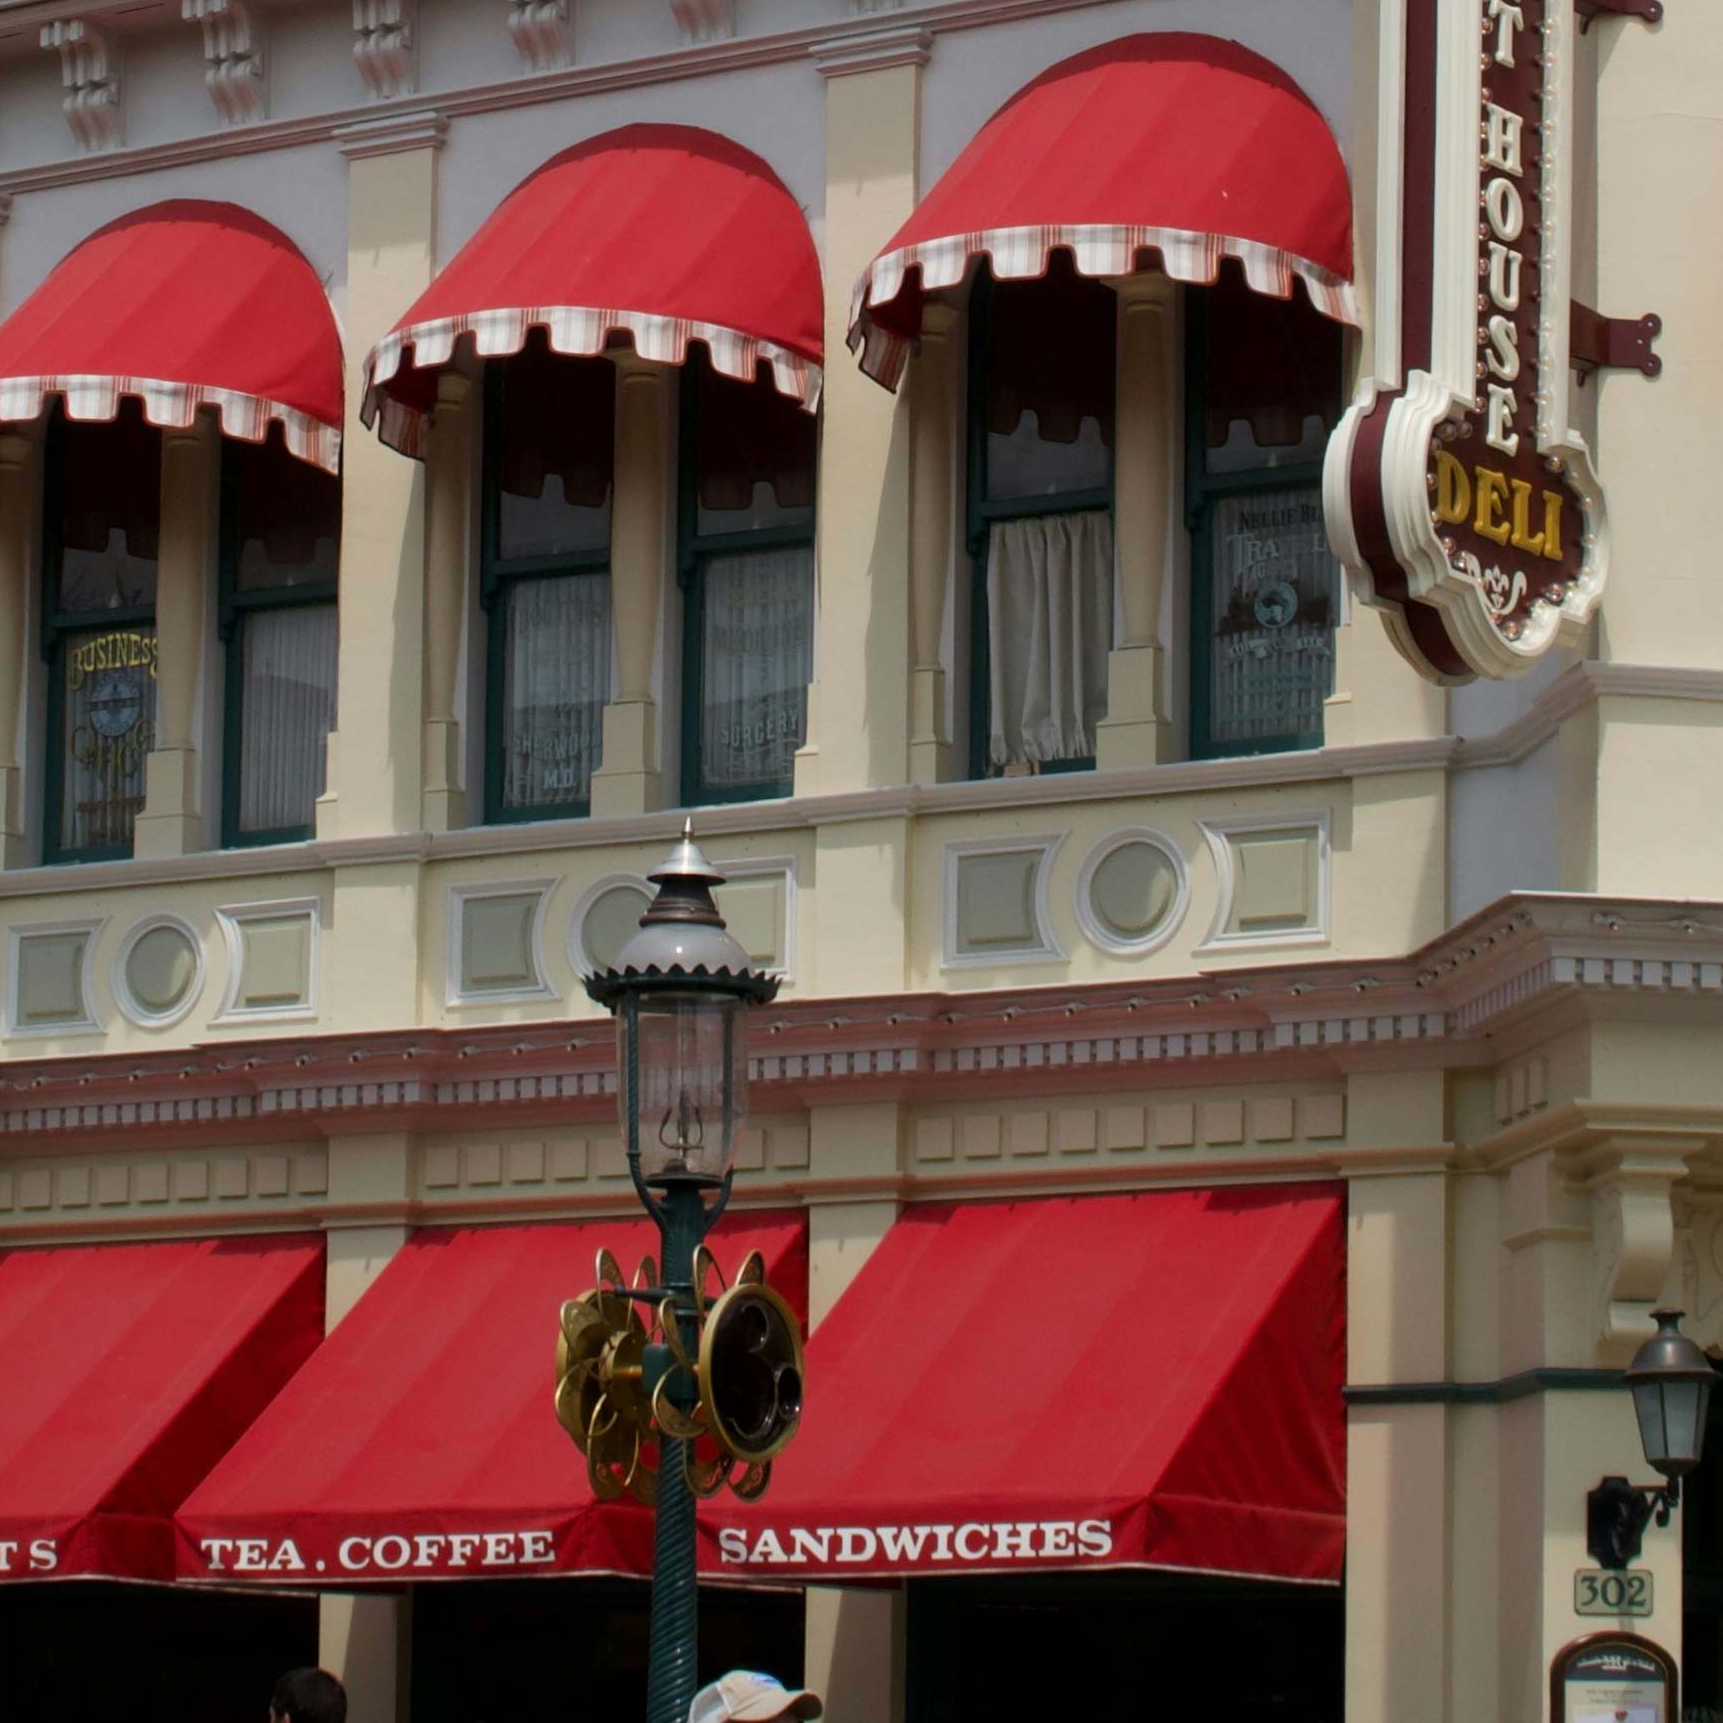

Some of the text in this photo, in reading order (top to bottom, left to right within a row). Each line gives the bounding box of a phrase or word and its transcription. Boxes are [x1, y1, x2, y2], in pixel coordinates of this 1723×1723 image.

[1484, 103, 1524, 457] HOUSE
[1434, 449, 1564, 561] DELI
[720, 709, 800, 748] SURGERY
[338, 1531, 557, 1570] COFFEE
[720, 1519, 1113, 1565] SANDWICHES
[1580, 1576, 1648, 1609] 302
